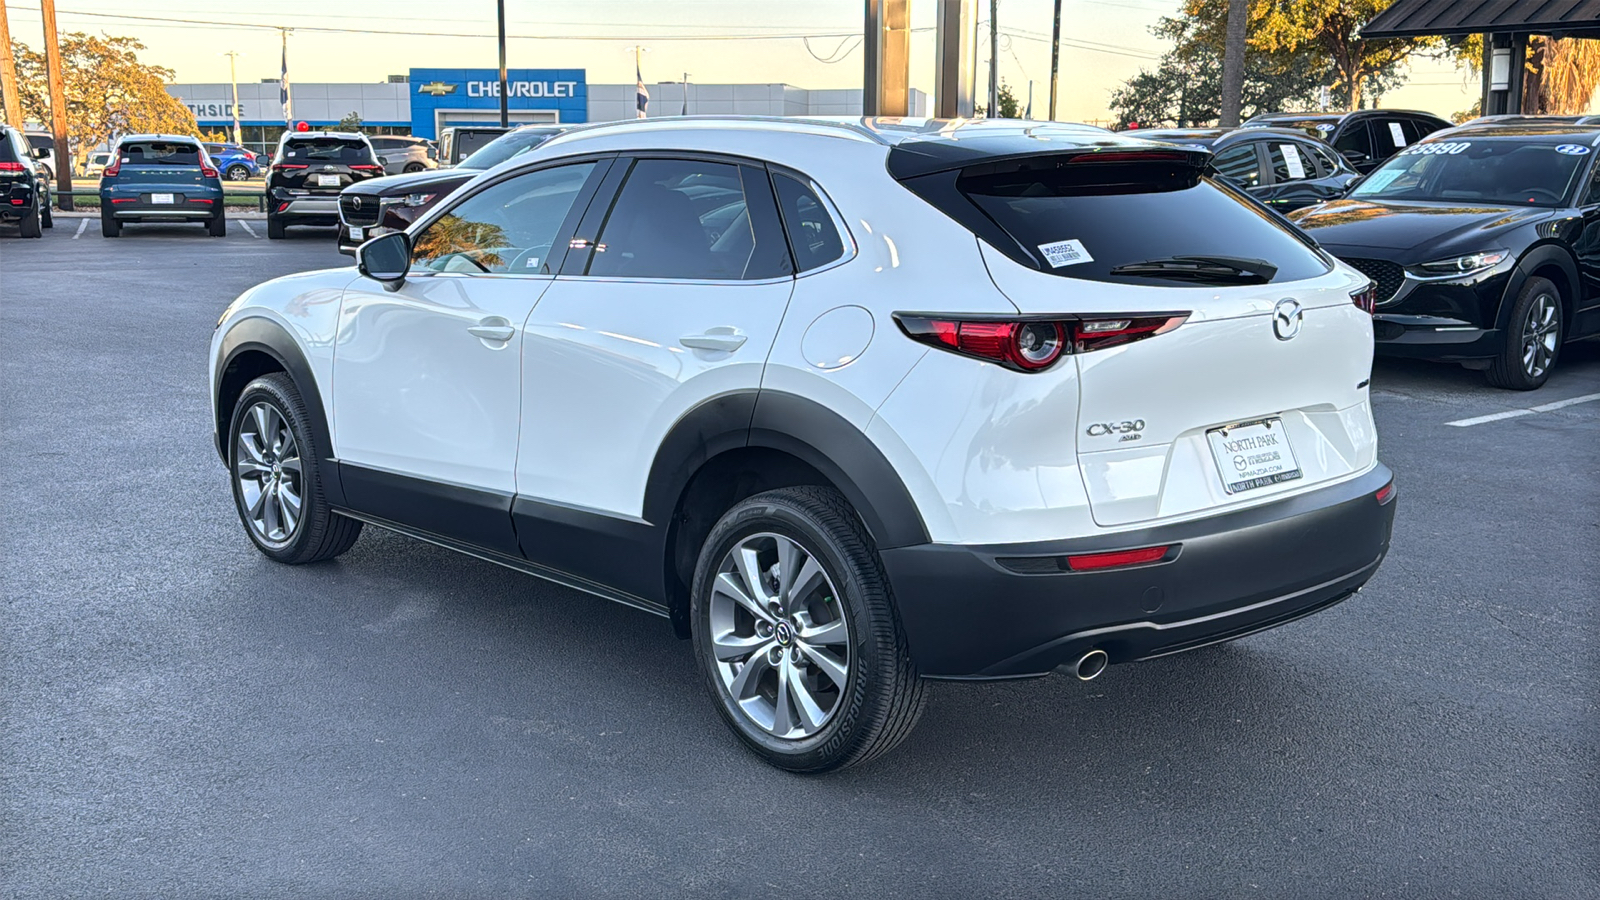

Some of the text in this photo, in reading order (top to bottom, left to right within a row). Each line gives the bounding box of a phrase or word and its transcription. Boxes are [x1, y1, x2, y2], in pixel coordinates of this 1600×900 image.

[467, 81, 577, 97] CHEVROLET
[1398, 142, 1472, 156] 23990
[1086, 419, 1146, 437] CX-30
[1223, 433, 1279, 454] NORTH PARK
[1231, 480, 1255, 493] NORTH
[1256, 477, 1273, 489] PARK
[817, 657, 868, 760] BRIDGESTONE
